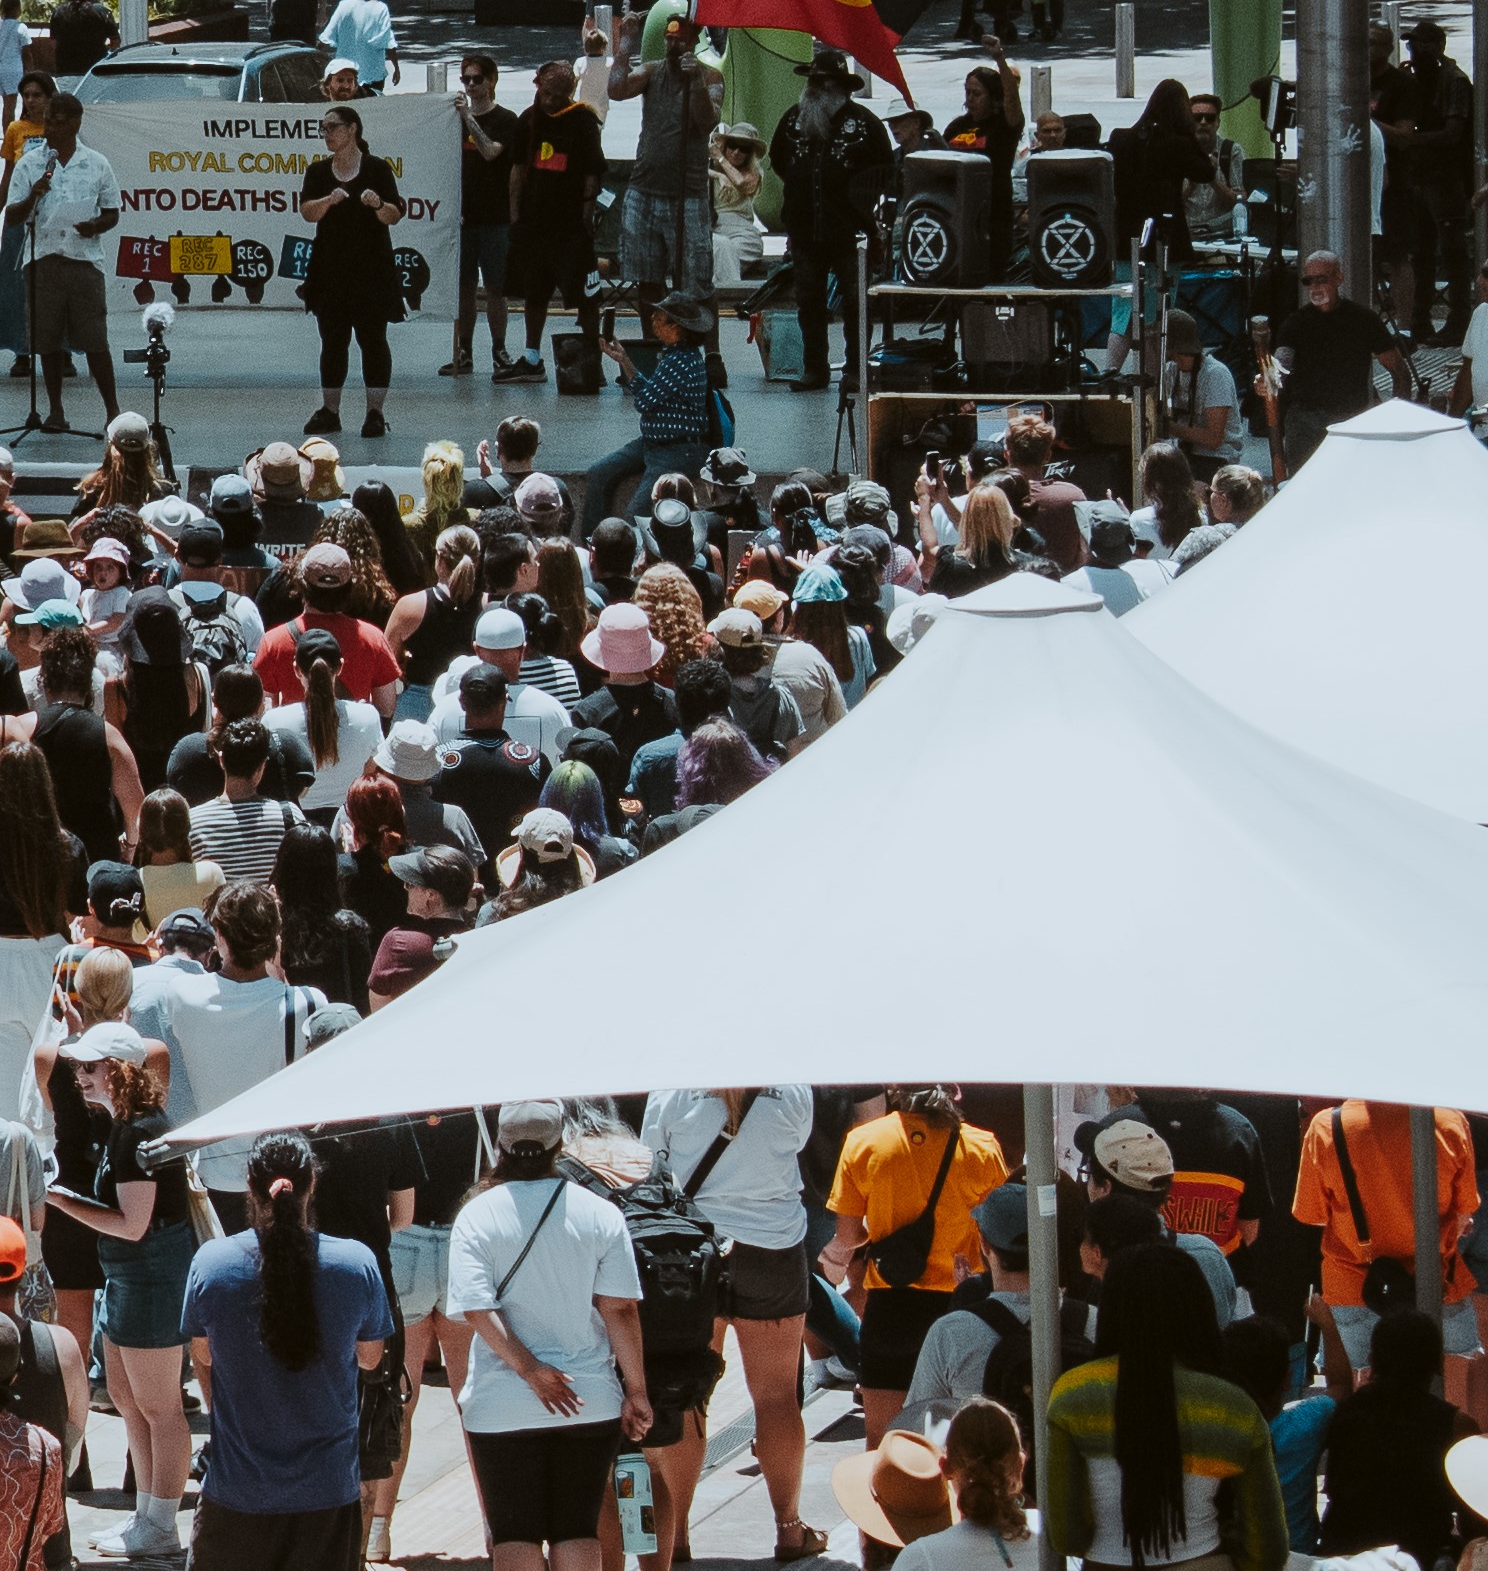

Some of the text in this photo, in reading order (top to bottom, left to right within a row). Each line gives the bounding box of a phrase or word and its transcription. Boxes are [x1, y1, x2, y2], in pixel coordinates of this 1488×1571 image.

[203, 119, 326, 140] IMPLEME
[148, 150, 235, 174] ROYAL
[120, 188, 177, 213] NTO
[189, 189, 288, 214] DEATHS
[132, 241, 163, 257] REC
[181, 237, 215, 254] REC
[236, 245, 265, 261] REC
[293, 241, 313, 261] RE
[178, 253, 218, 271] 287
[394, 253, 419, 269] REC
[236, 263, 268, 279] 150
[402, 271, 412, 288] 2
